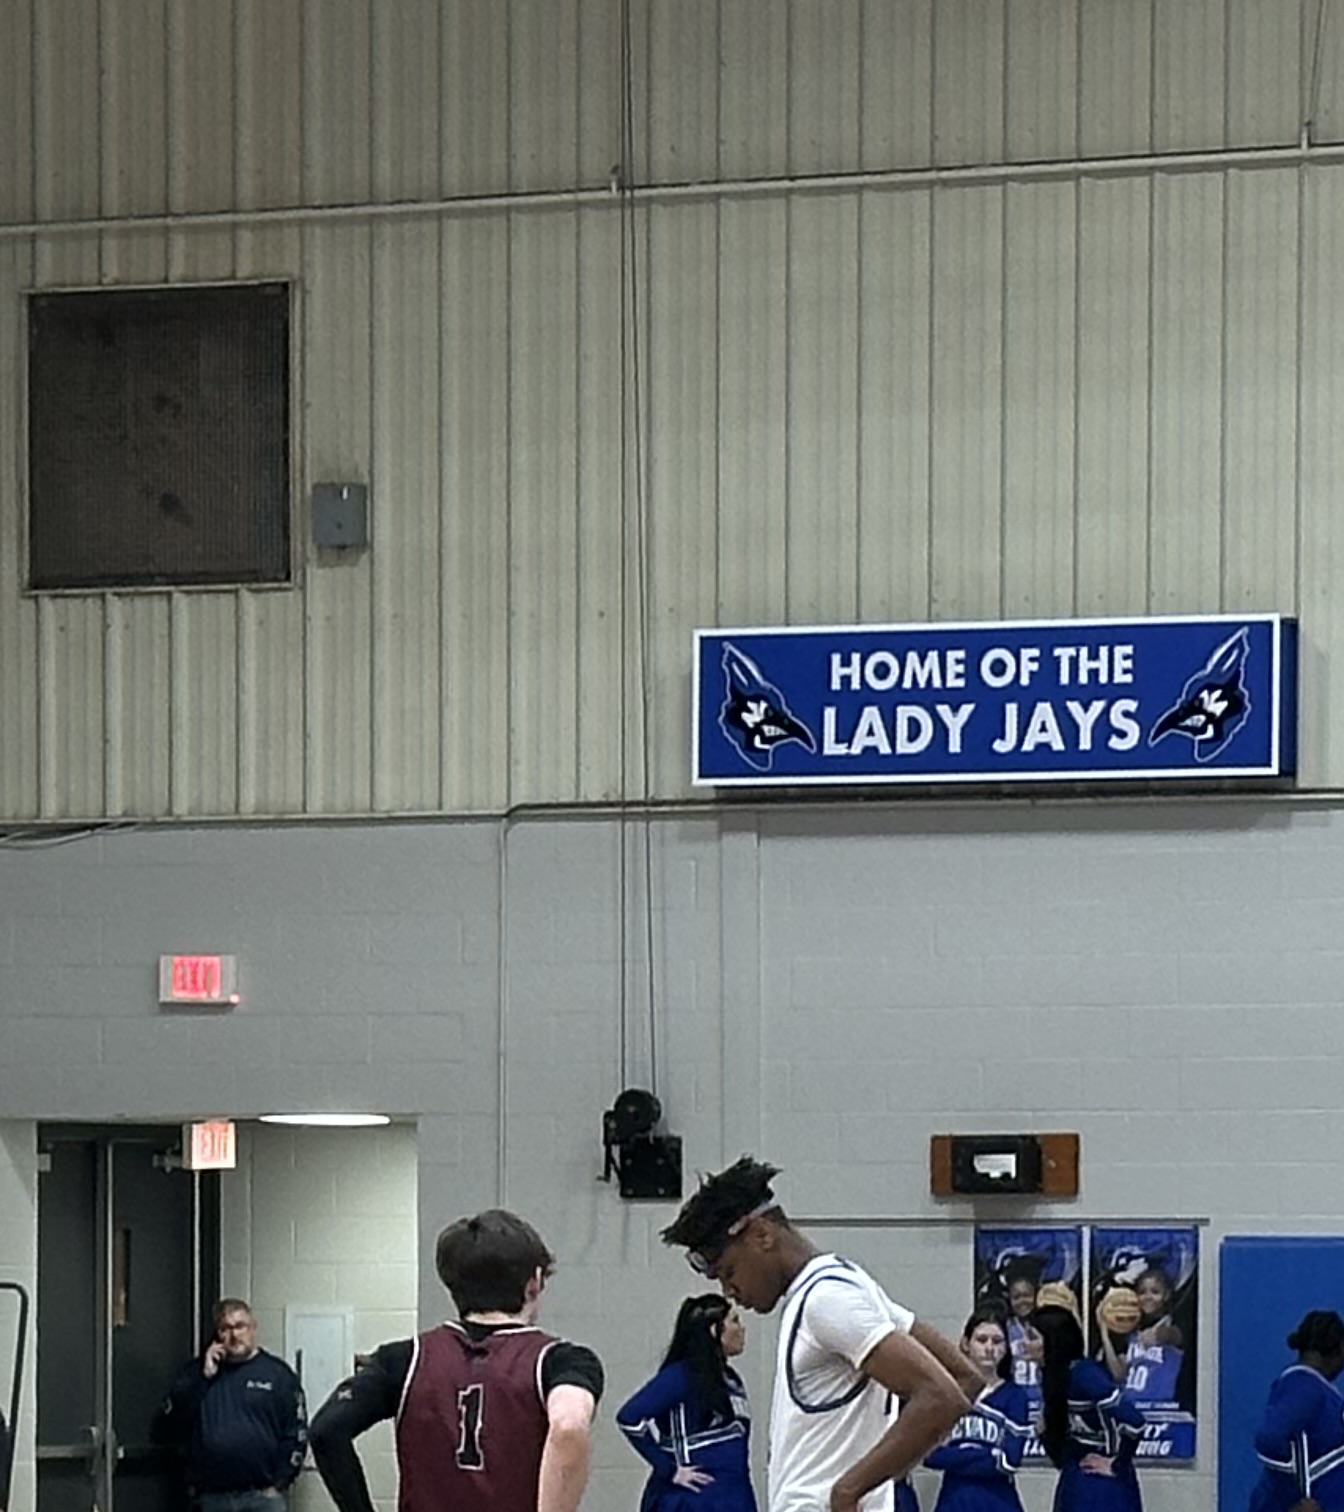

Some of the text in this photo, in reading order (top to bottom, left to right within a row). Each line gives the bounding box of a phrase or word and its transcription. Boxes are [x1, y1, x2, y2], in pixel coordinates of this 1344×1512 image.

[829, 644, 1134, 691] HOME OF THE
[822, 700, 1140, 756] LADY JAYS
[457, 1383, 485, 1470] 1
